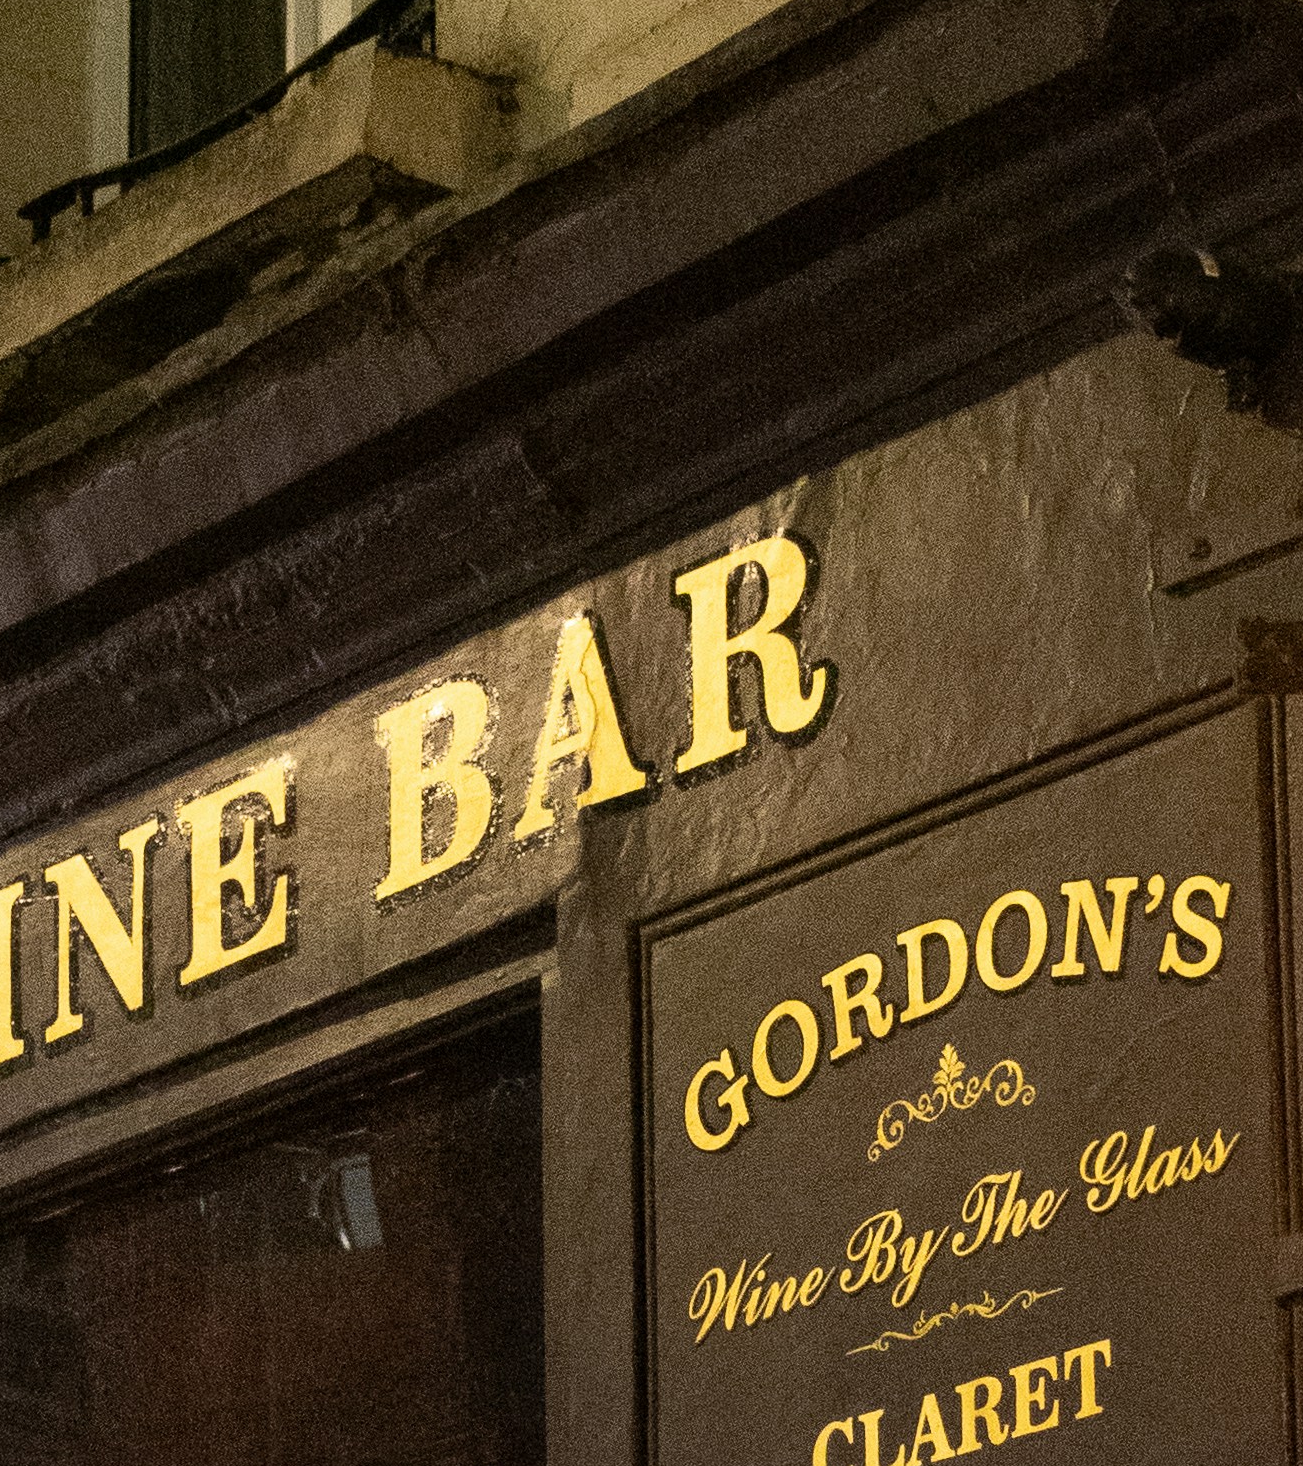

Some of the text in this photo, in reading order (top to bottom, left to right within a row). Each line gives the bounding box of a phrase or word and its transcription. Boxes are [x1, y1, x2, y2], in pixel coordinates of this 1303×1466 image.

[374, 526, 830, 903] BAR
[684, 874, 1232, 1151] GORDON'S
[688, 1124, 1240, 1343] Wine By The Glass
